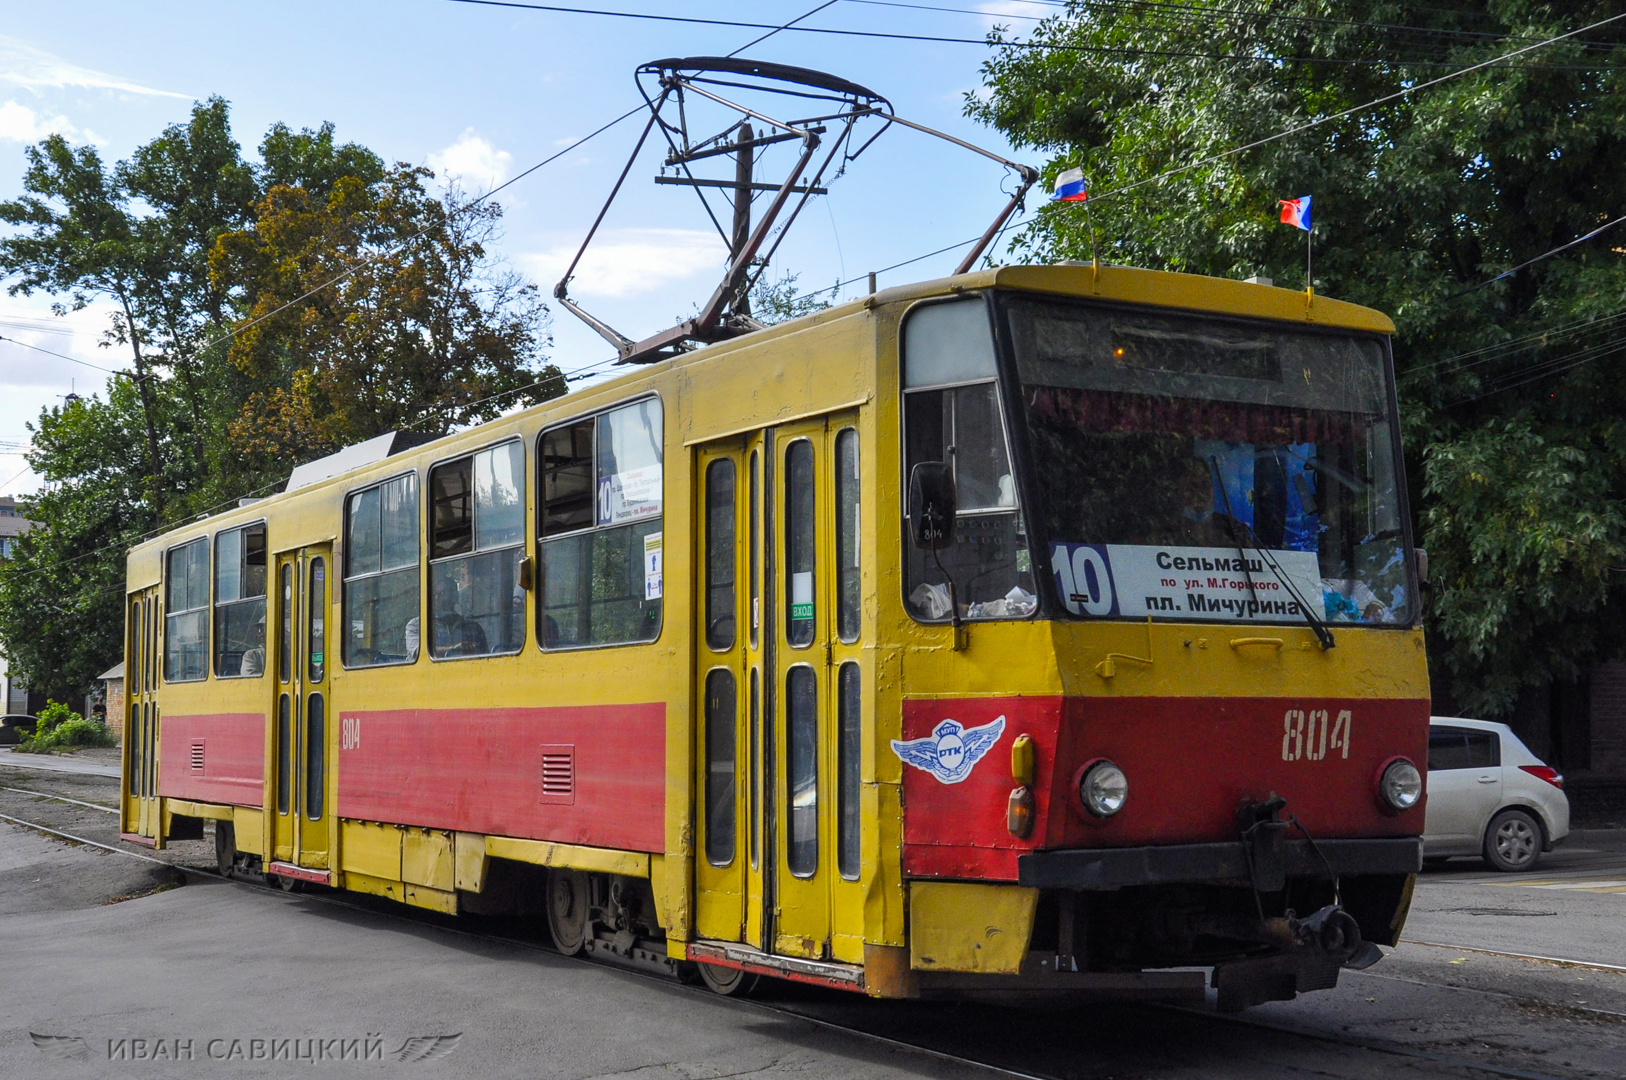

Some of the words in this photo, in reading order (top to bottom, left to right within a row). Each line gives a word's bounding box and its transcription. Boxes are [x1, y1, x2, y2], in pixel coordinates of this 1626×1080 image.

[599, 481, 611, 520] 10
[1155, 551, 1263, 573] Сельмаш
[1051, 545, 1112, 615] 10
[1160, 578, 1177, 588] по
[1184, 579, 1204, 590] ул.
[793, 605, 812, 617] ВХОД
[1145, 596, 1182, 611] пл.
[1186, 593, 1301, 618] Мичурина
[342, 718, 360, 750] 804
[940, 726, 956, 735] МУП
[1282, 709, 1352, 761] 804
